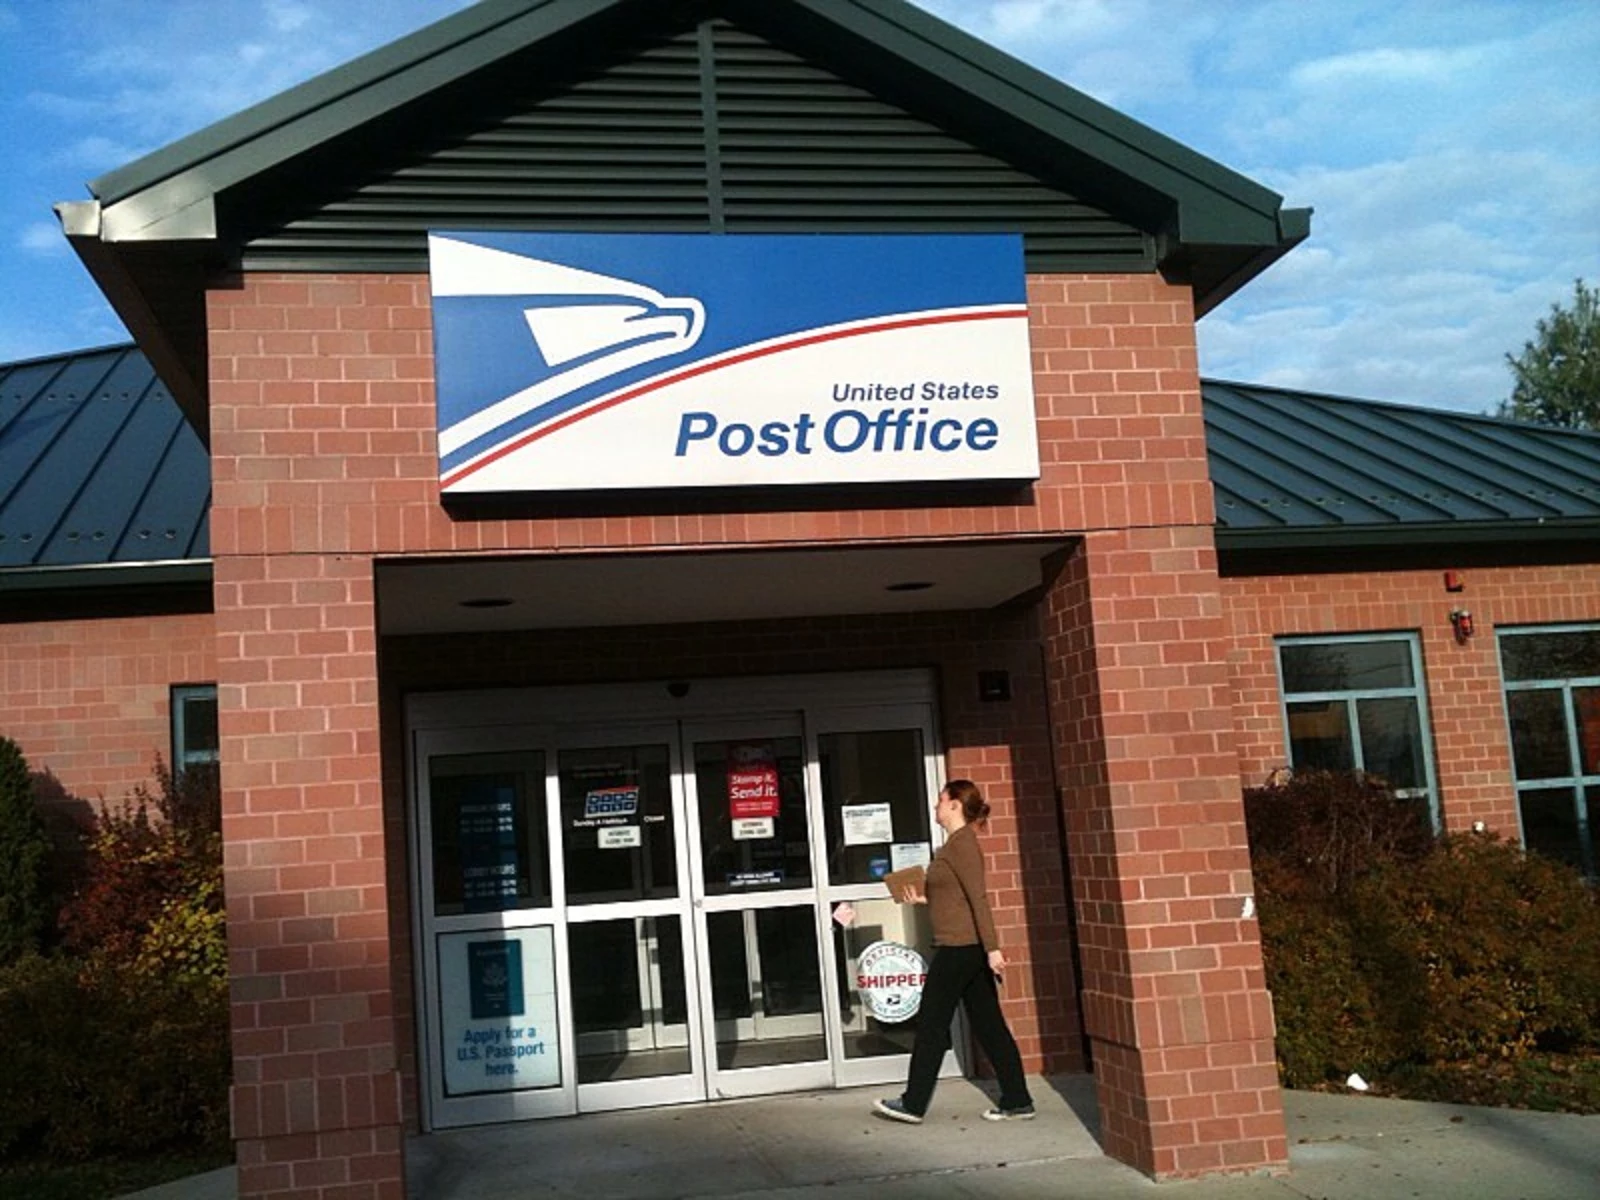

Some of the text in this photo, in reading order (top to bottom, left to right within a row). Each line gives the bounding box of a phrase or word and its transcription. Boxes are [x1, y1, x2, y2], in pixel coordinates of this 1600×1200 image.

[832, 381, 999, 402] United States
[674, 407, 999, 457] Post Office
[730, 785, 778, 799] Send it.
[464, 1025, 537, 1044] Apply for a
[457, 1041, 545, 1061] U.S. Passport
[485, 1062, 519, 1077] here.
